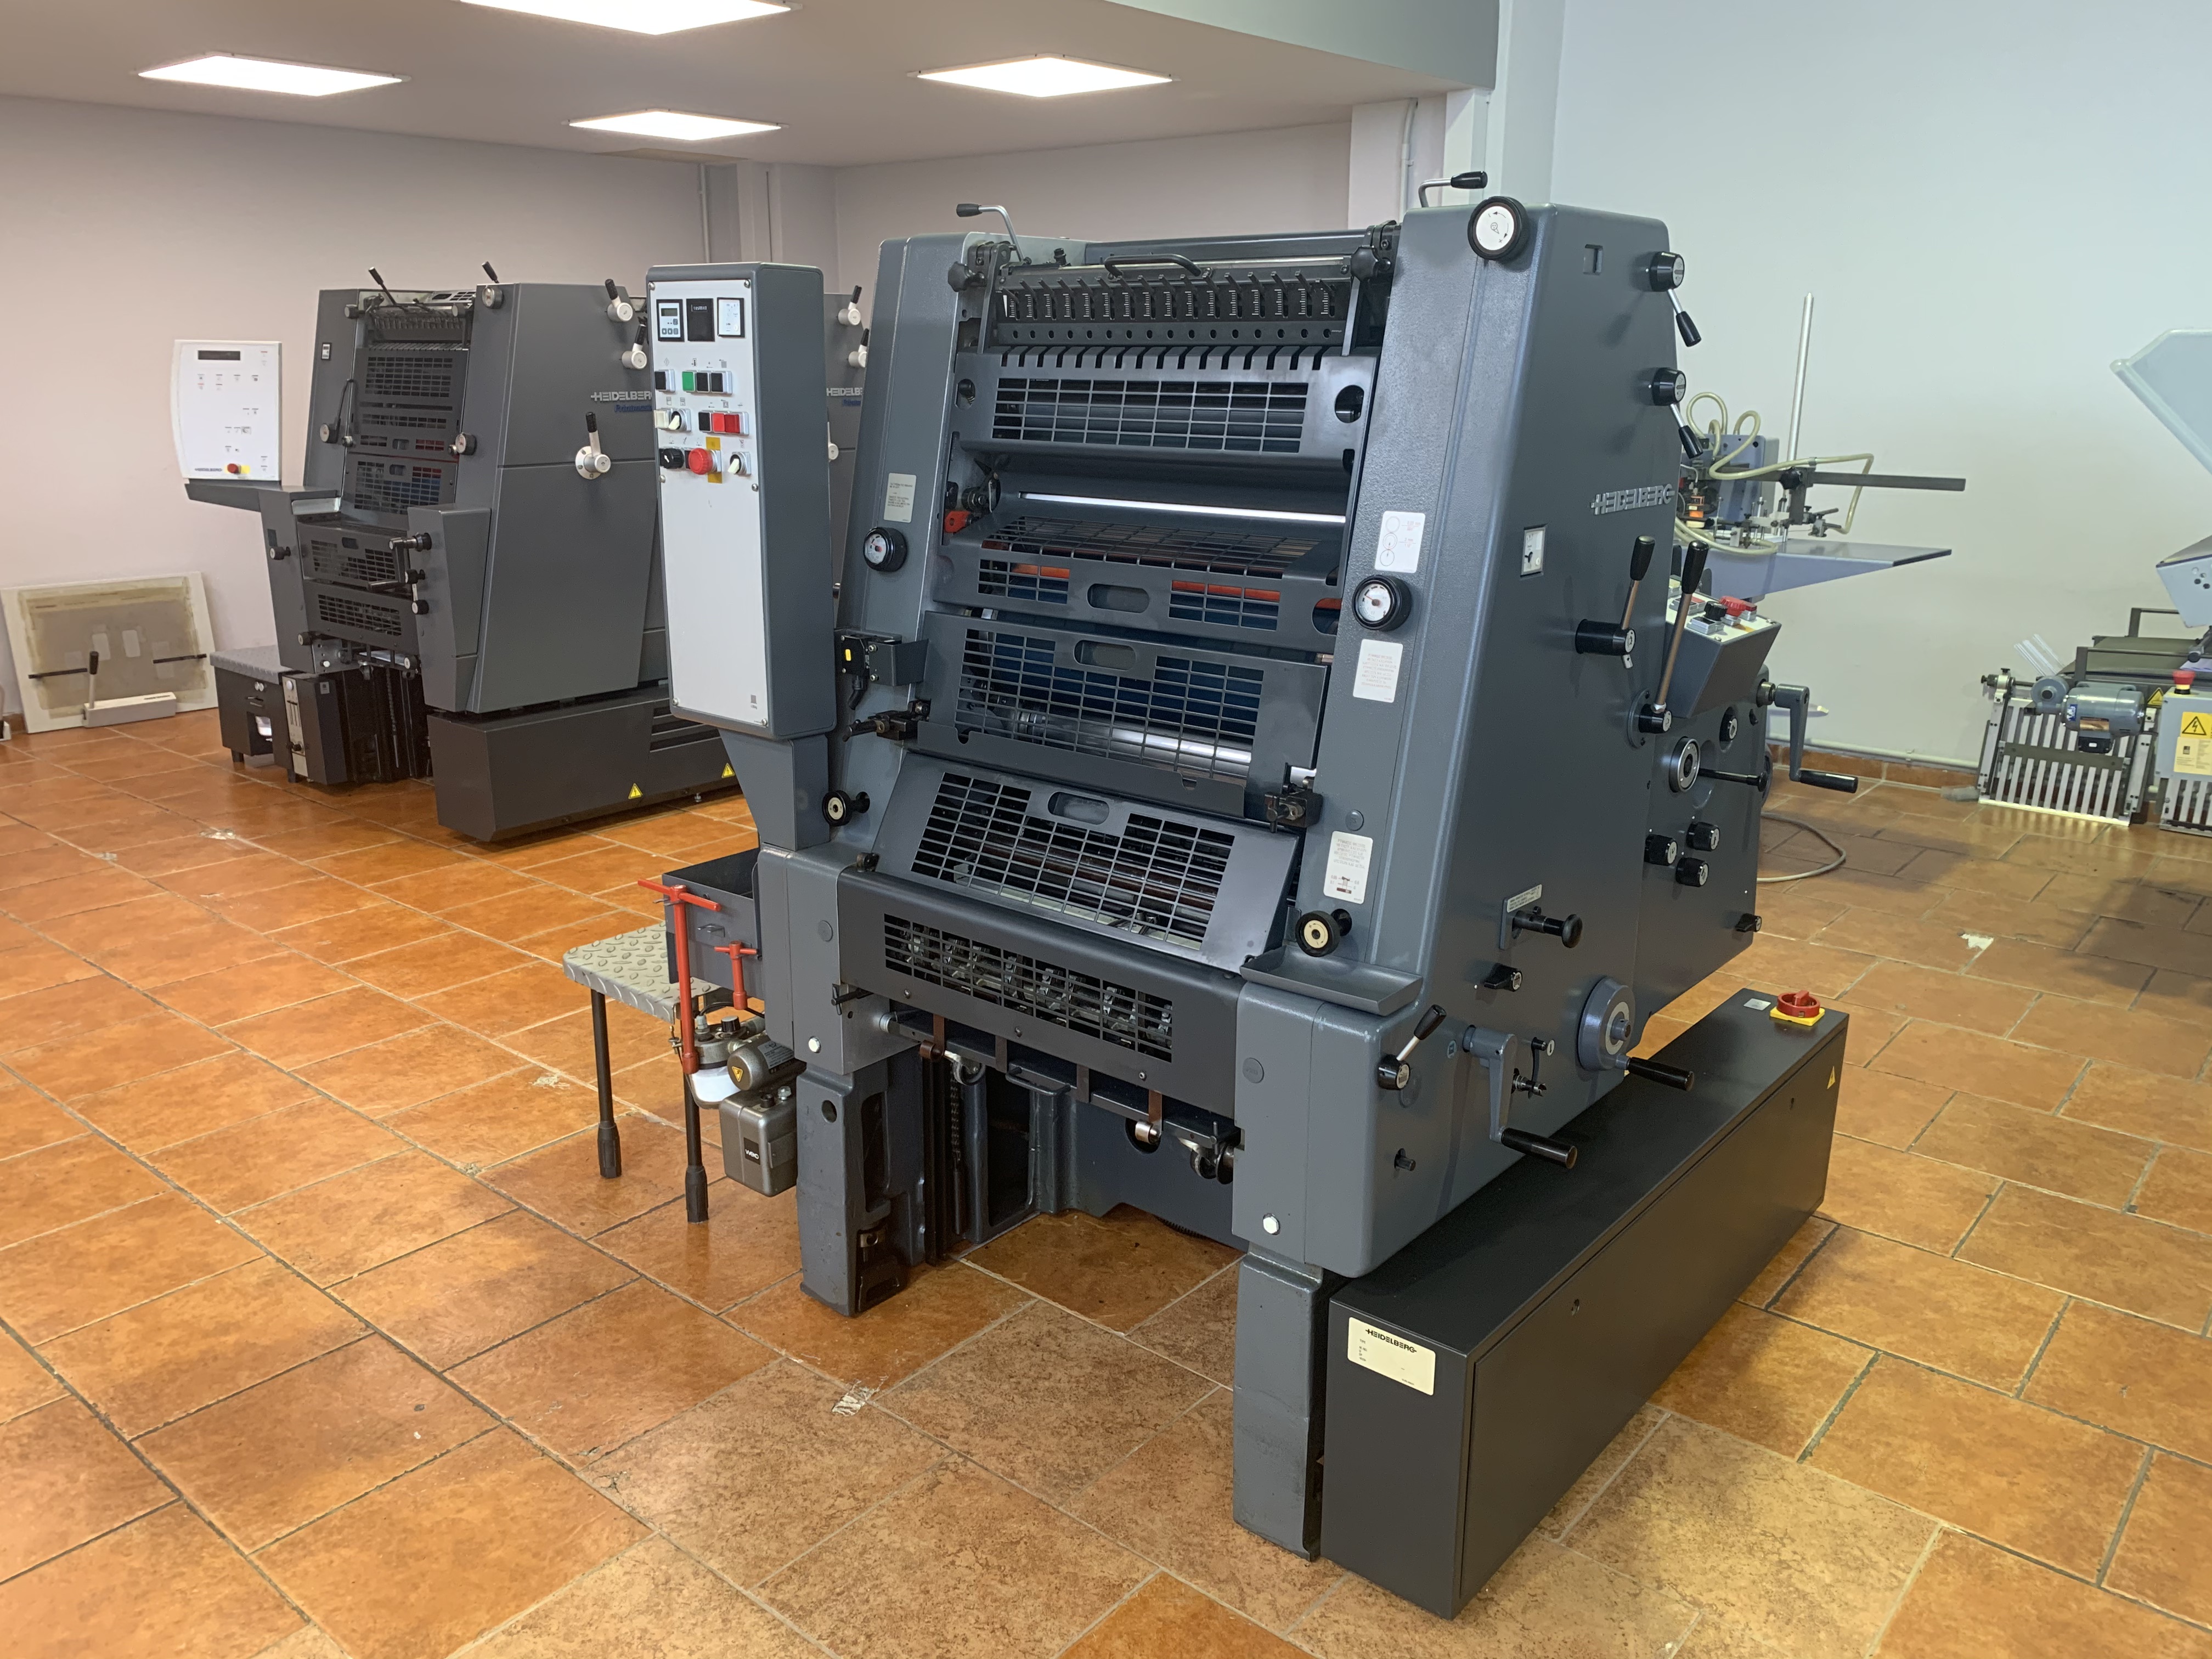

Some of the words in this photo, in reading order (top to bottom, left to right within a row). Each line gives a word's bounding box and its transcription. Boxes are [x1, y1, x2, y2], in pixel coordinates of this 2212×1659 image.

[590, 391, 652, 401] HEIDELBER
[1591, 483, 1675, 515] HEIDELBERG
[1365, 1329, 1417, 1353] HEIDELBERG
